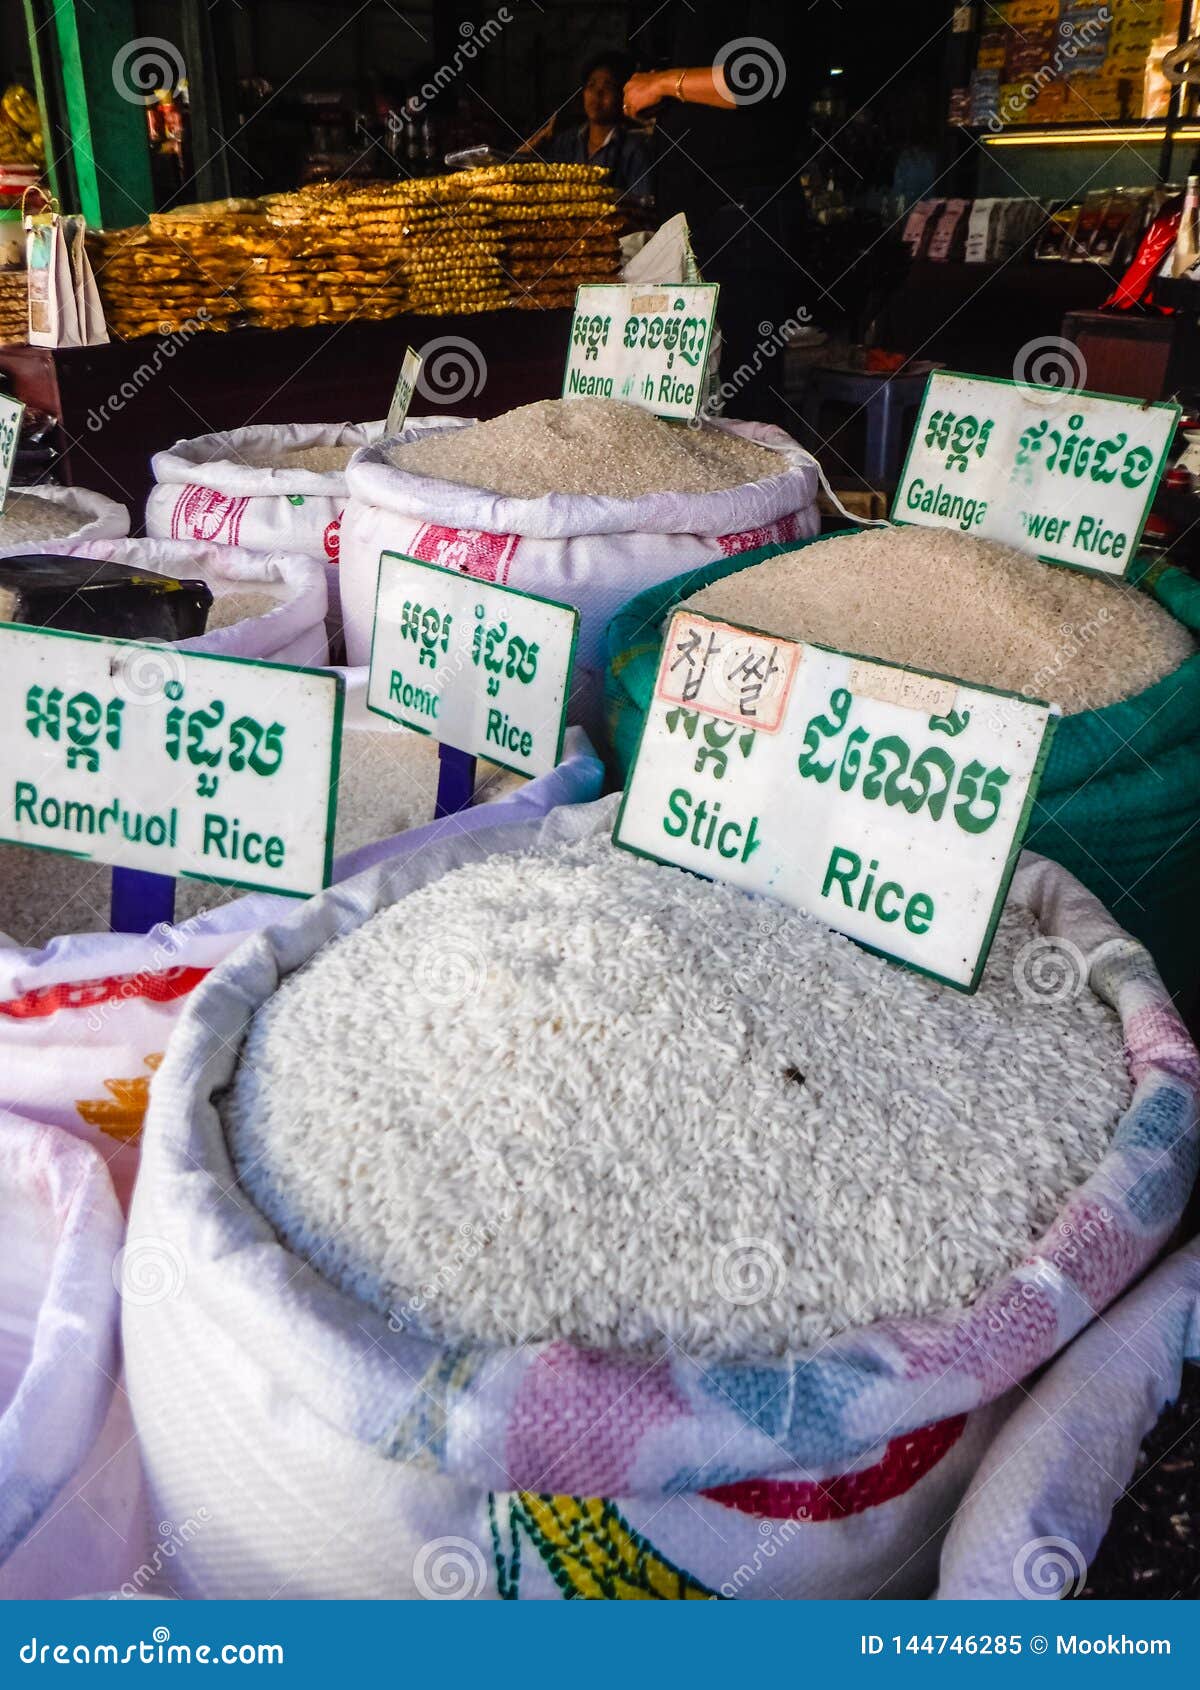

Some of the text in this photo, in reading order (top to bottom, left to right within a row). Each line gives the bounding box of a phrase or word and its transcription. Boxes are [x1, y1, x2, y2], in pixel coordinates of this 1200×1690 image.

[573, 315, 612, 360] អង្ករ
[658, 374, 694, 405] Rice
[924, 409, 995, 473] អង្ករ
[1073, 515, 1127, 558] Rice
[400, 600, 453, 669] អង្ករ
[26, 684, 125, 773] អង្ករ
[486, 708, 532, 757] Rice
[15, 781, 285, 868] Romduol Rice
[821, 846, 935, 935] Rice
